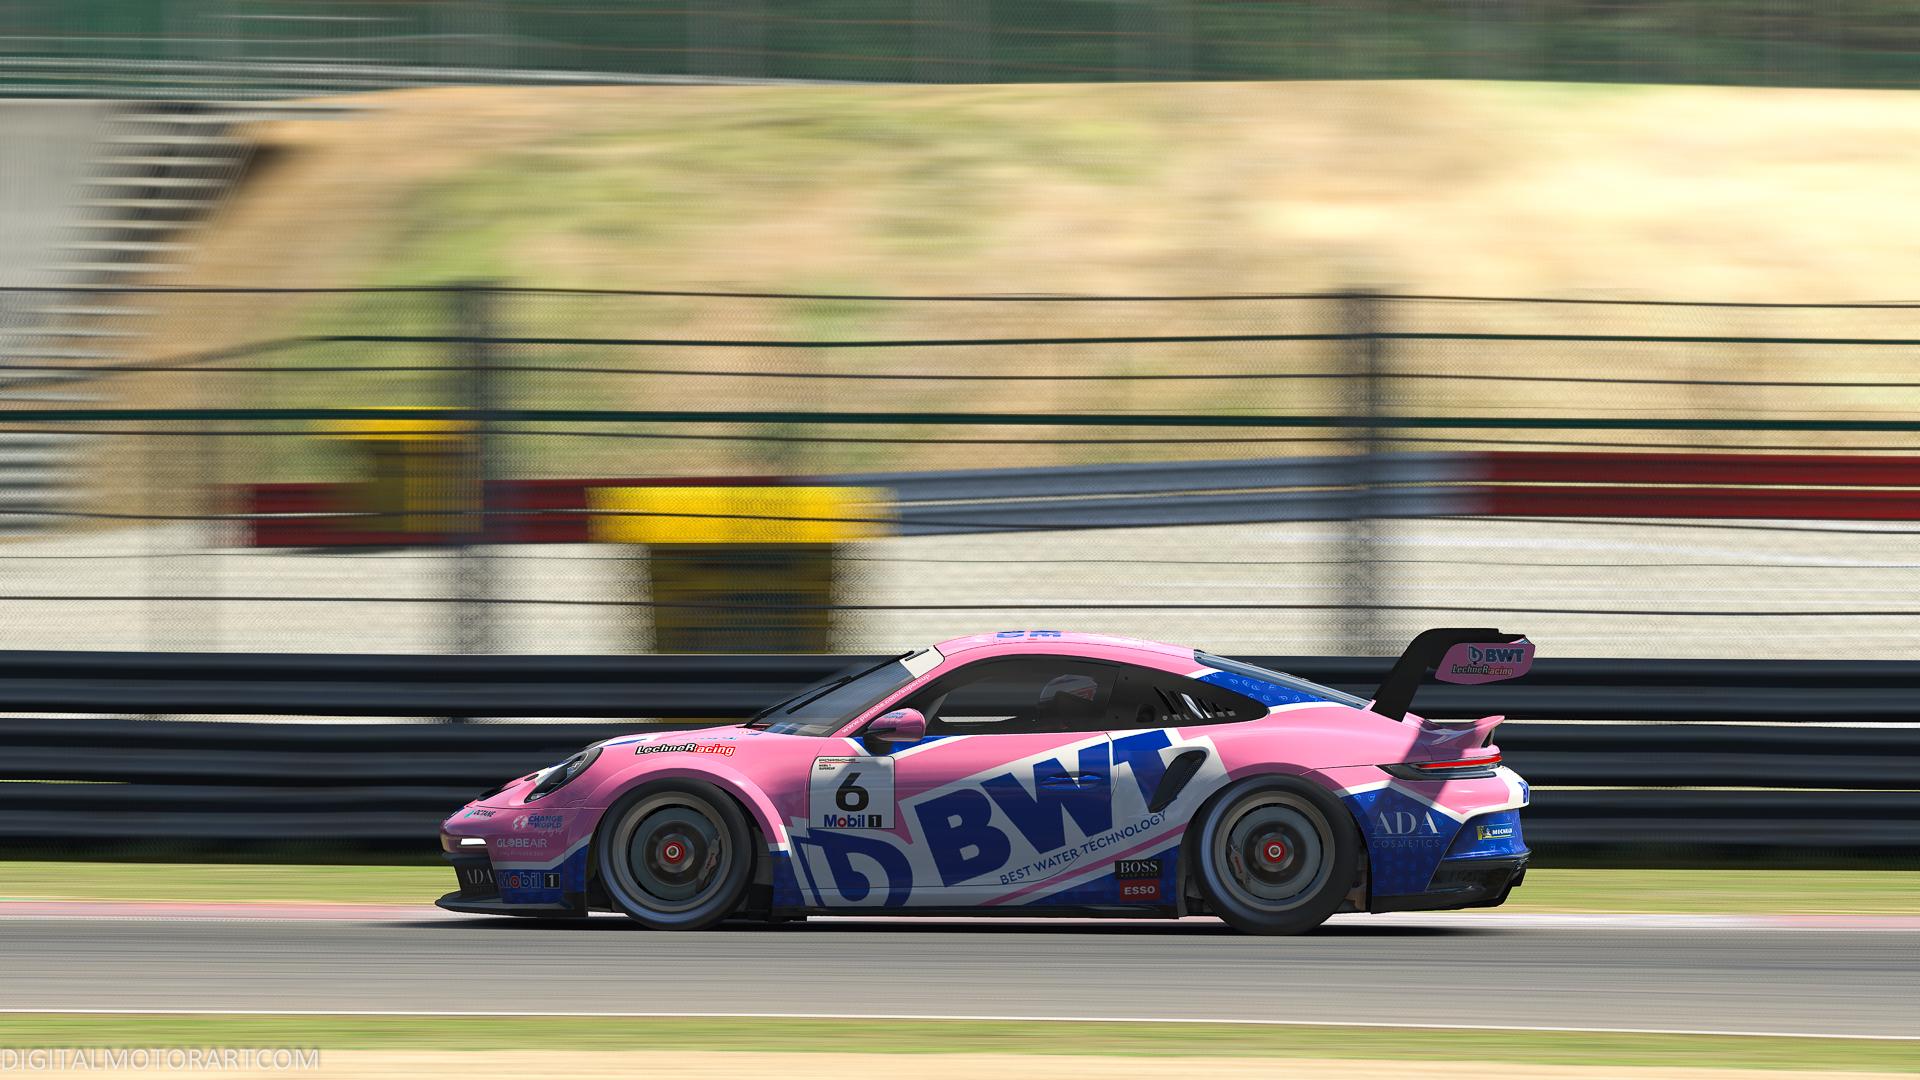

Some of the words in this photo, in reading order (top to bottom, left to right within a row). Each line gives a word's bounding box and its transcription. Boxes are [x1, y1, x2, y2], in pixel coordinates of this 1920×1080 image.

[1485, 648, 1524, 663] BWT
[1451, 664, 1513, 676] LechneRacing
[635, 743, 736, 757] LechneRacing
[836, 773, 869, 812] 6
[914, 729, 1174, 887] BWT
[824, 814, 866, 828] Mobil
[1372, 811, 1441, 835] ADA
[497, 838, 548, 848] GLOBEAIR
[1000, 866, 1032, 885] BEST
[1033, 848, 1079, 872] WATER
[1081, 810, 1167, 855] TECHNOLOGY
[1373, 839, 1441, 849] COSMETICS
[1120, 860, 1159, 873] BOSS
[466, 868, 494, 885] ADA
[498, 871, 542, 889] Mobil
[1124, 886, 1156, 896] ESSO
